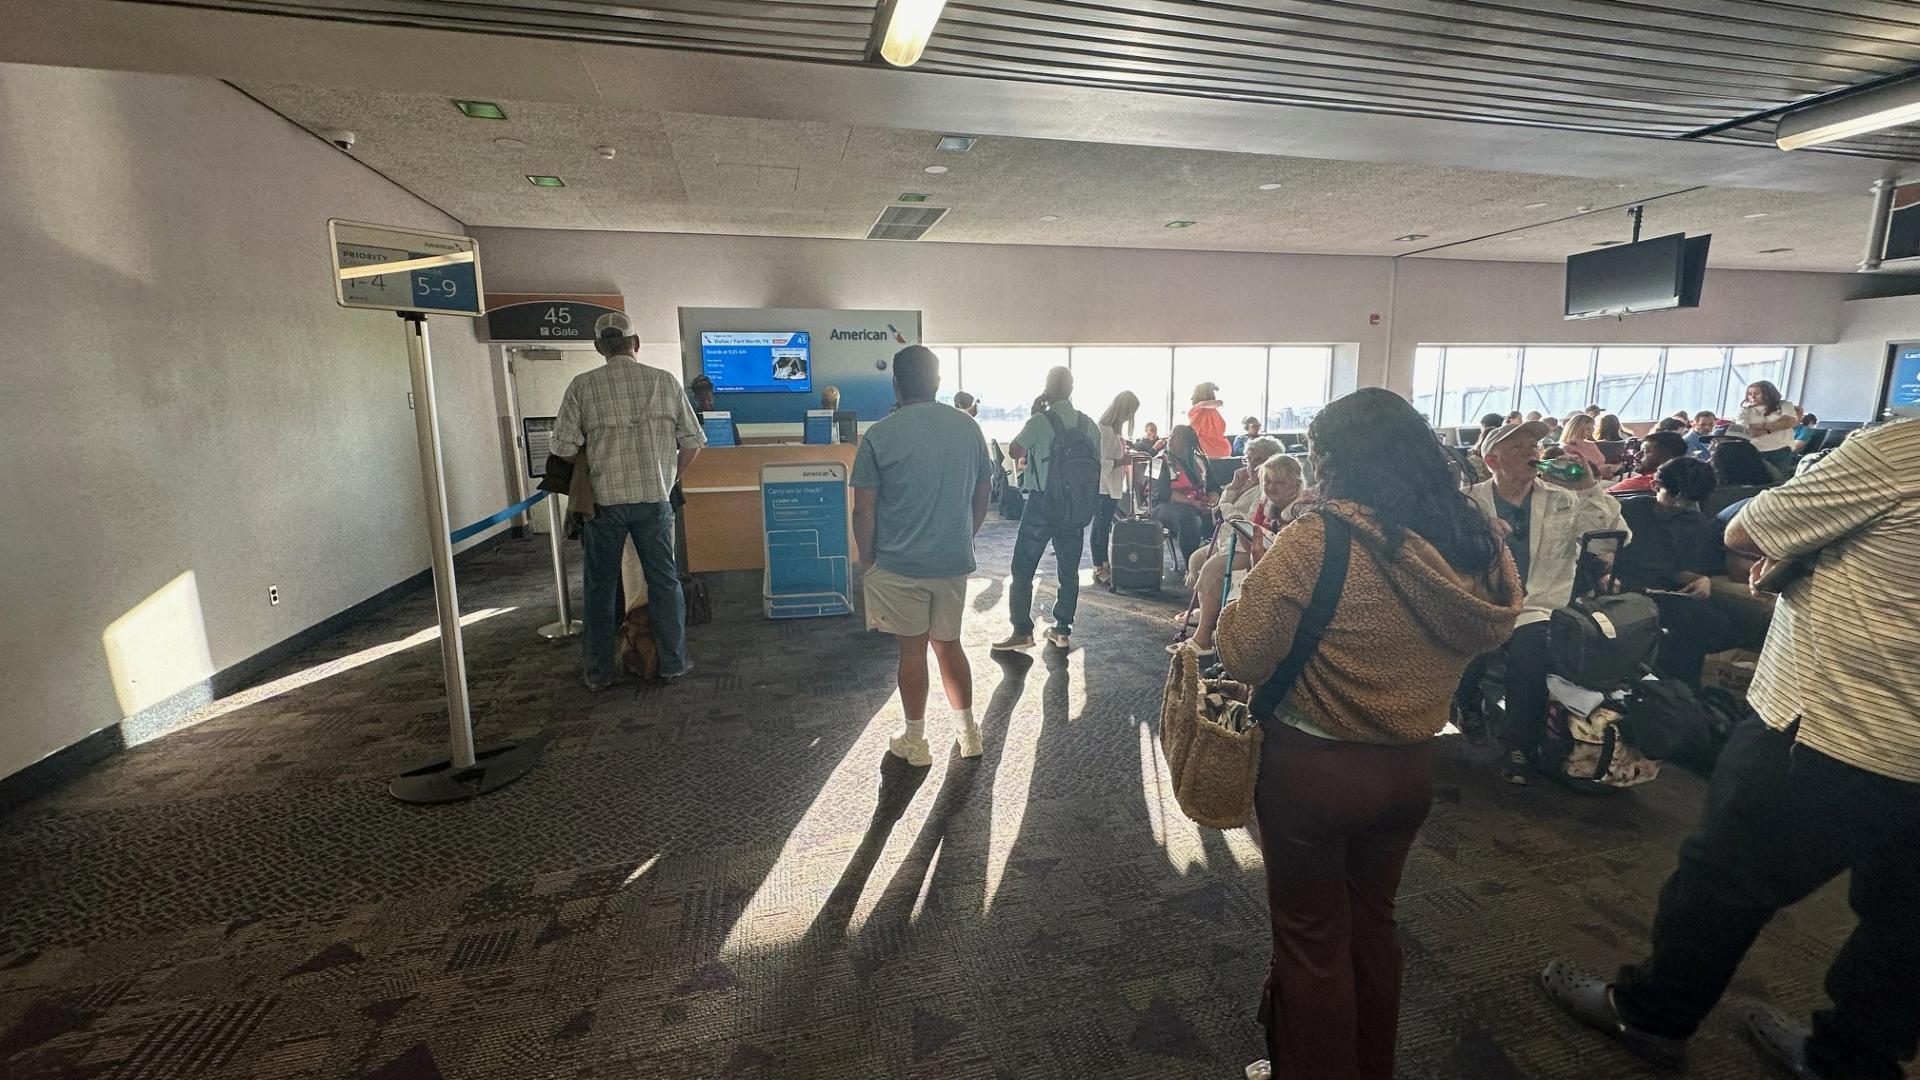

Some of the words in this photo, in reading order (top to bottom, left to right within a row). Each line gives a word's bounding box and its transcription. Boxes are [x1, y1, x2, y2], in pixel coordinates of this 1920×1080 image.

[343, 250, 388, 262] PRIORITY
[544, 307, 571, 324] 45
[551, 327, 579, 336] Gate
[830, 328, 887, 341] American
